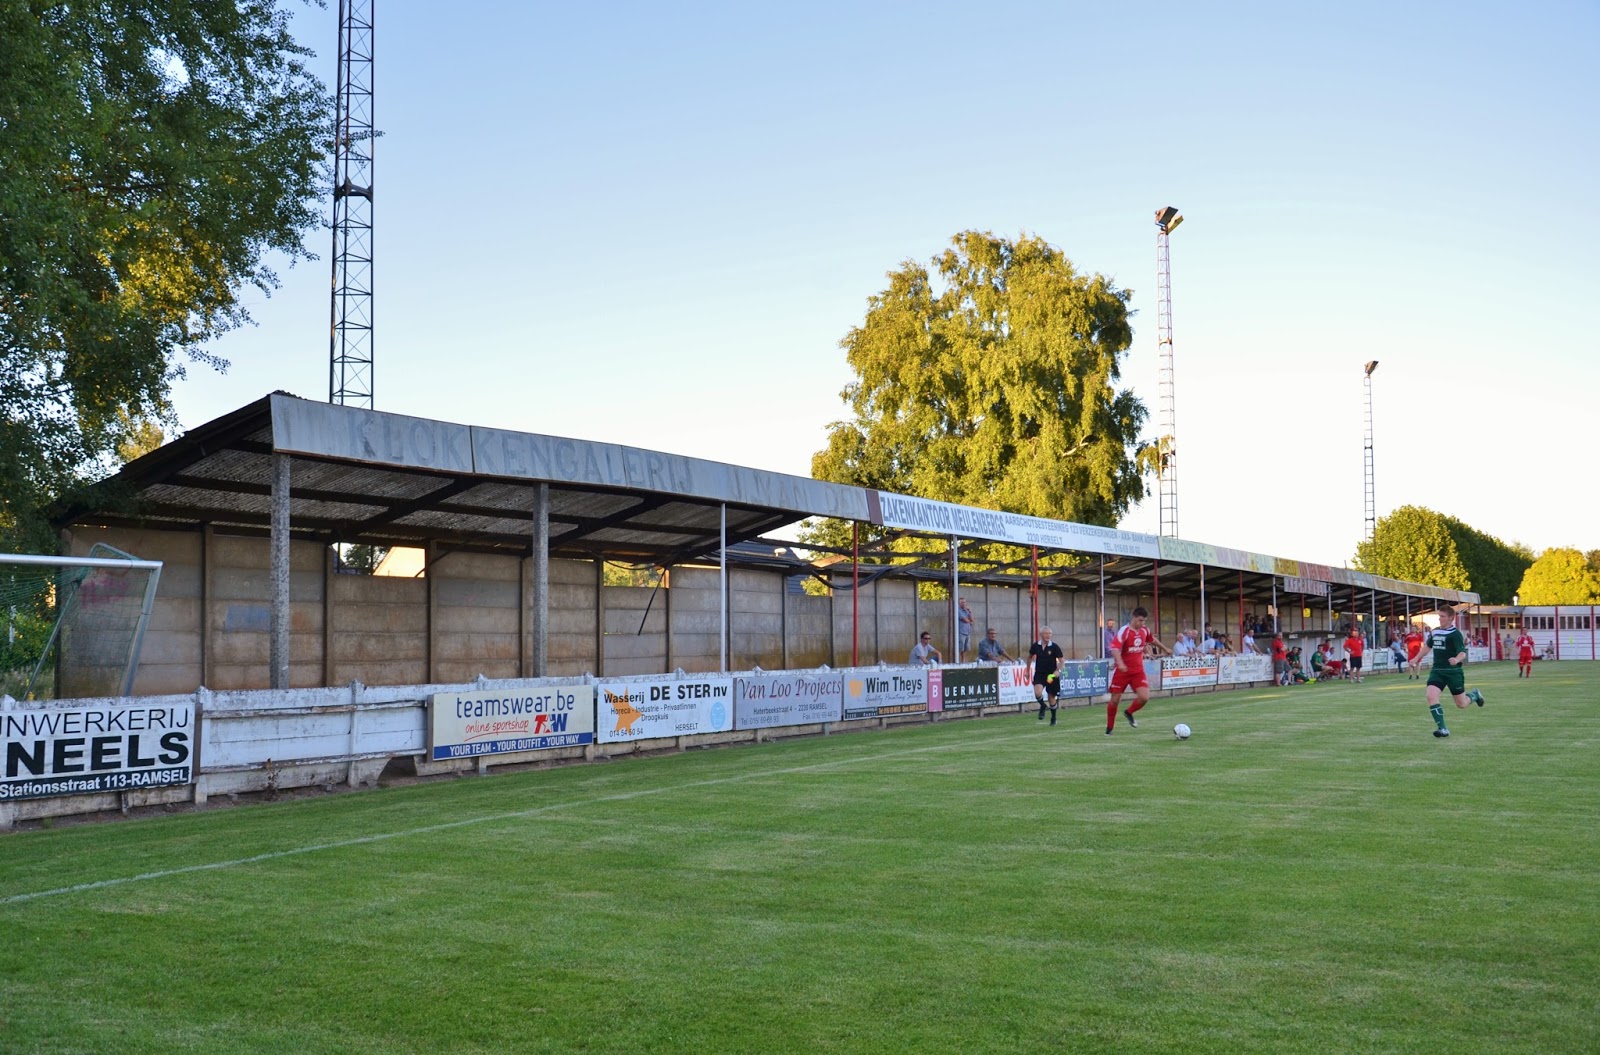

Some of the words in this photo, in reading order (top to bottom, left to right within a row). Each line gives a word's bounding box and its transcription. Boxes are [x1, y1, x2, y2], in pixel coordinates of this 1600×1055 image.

[880, 496, 952, 530] ZAKENKANTOOR
[950, 507, 1006, 537] MEULENBERGS
[737, 678, 766, 699] Van
[769, 679, 791, 698] Loo
[795, 678, 841, 702] Projects
[866, 677, 889, 693] Wim
[893, 676, 922, 694] Theys
[1060, 676, 1075, 690] elmos
[1076, 675, 1092, 689] elmos
[1093, 674, 1107, 688] elmos
[604, 691, 645, 704] Wasserij
[651, 686, 670, 701] DE
[677, 684, 710, 699] STER
[713, 686, 727, 697] nv
[456, 690, 574, 718] teamswear.be
[611, 707, 630, 715] Horeca
[636, 704, 659, 713] Industrie
[664, 703, 696, 711] Privaatlinnen
[0, 708, 188, 737] NWERKERIJ
[466, 719, 490, 733] online
[492, 717, 529, 735] sportshop
[641, 712, 668, 722] Droogkuis
[675, 723, 698, 731] HERSELT
[0, 732, 188, 778] NEELS
[450, 745, 470, 756] YOUR
[471, 743, 492, 754] TEAM
[496, 740, 516, 752] YOUR
[517, 738, 541, 750] OUTFIT
[546, 736, 565, 747] YOUR
[566, 735, 579, 744] WAY
[0, 777, 100, 798] Stationsstraat
